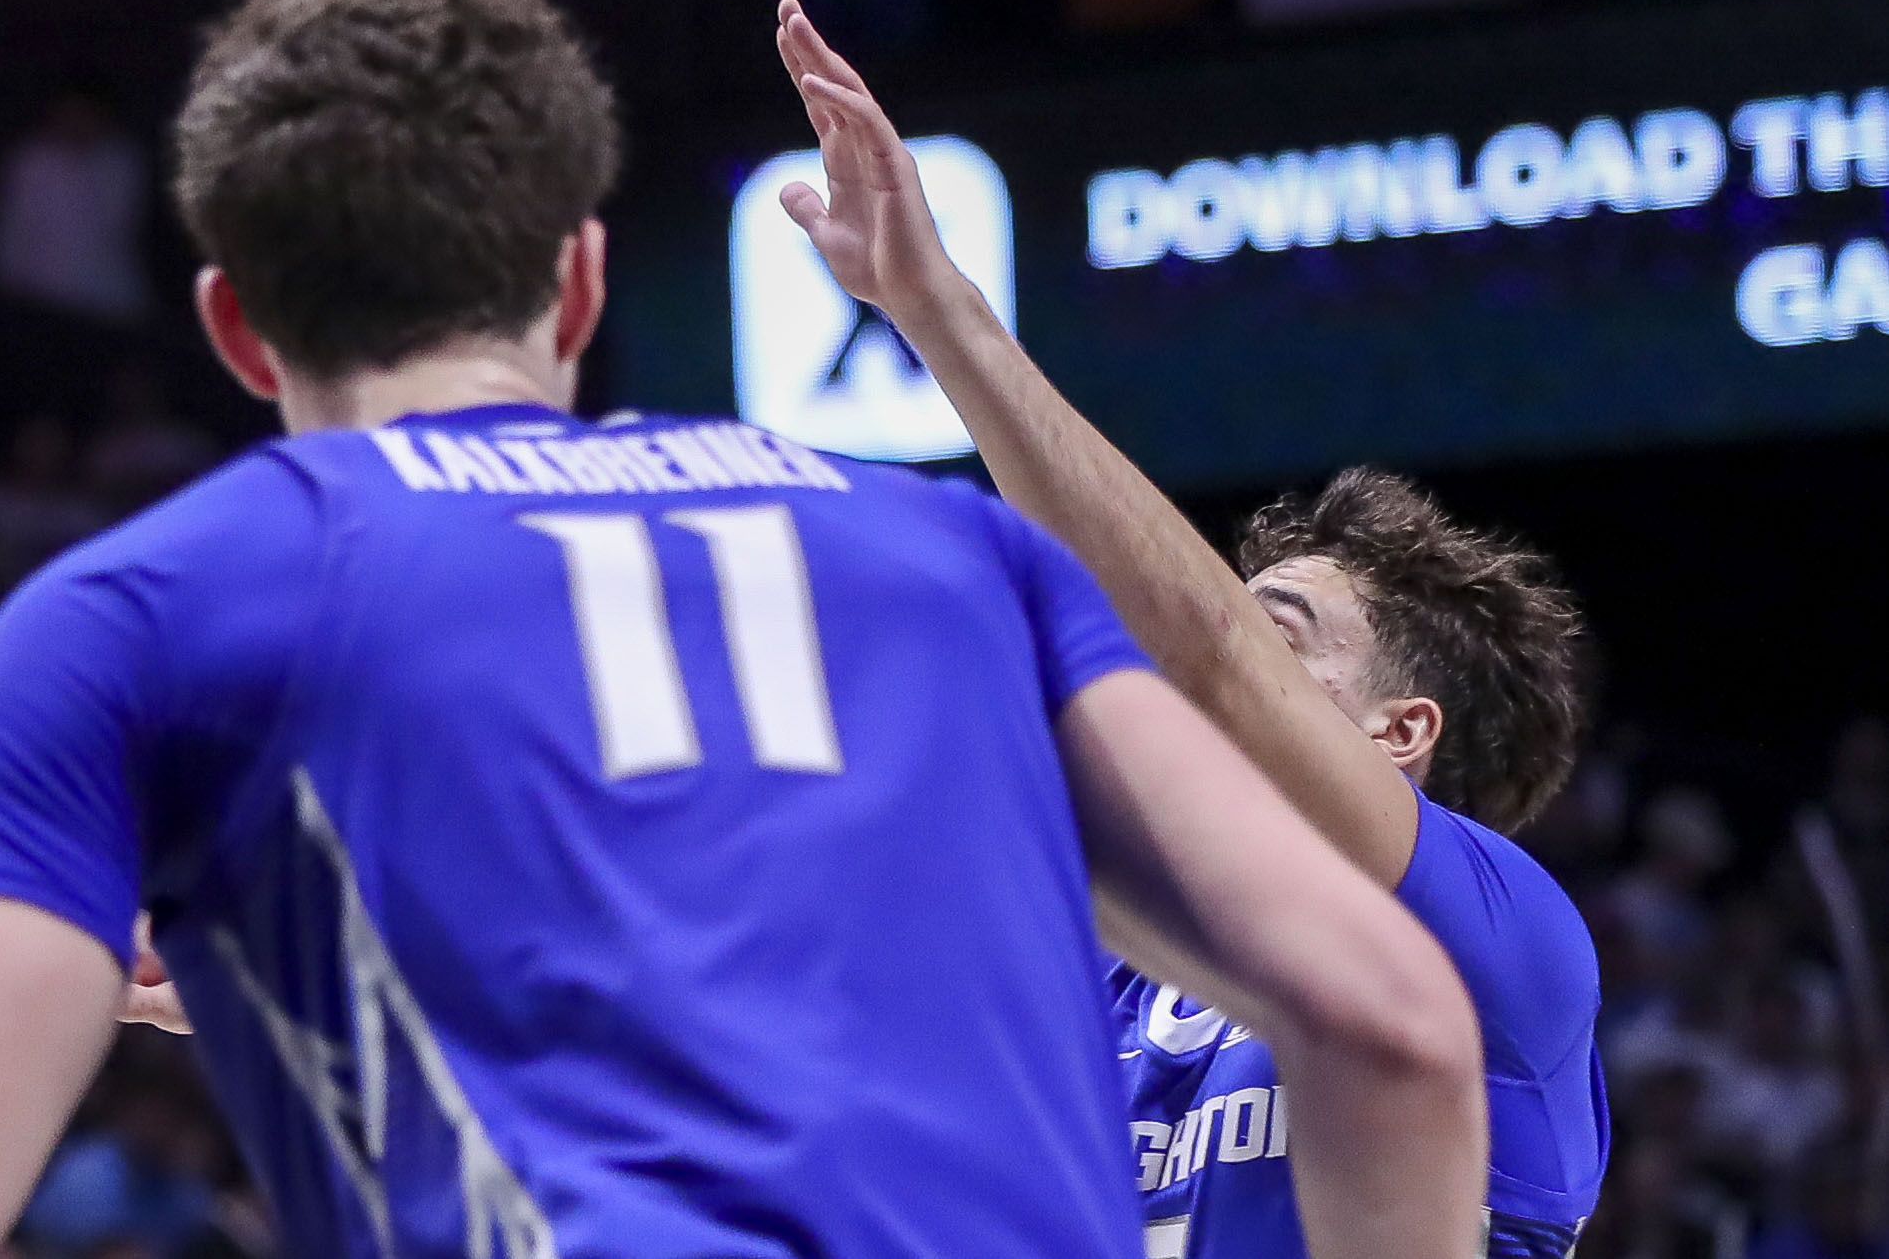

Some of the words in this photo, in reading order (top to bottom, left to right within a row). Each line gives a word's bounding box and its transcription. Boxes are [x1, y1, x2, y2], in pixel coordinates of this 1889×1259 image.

[1086, 106, 1727, 270] DOWNLOAD
[1729, 86, 1889, 198] TH
[1735, 237, 1889, 347] GA
[513, 502, 847, 782] 11
